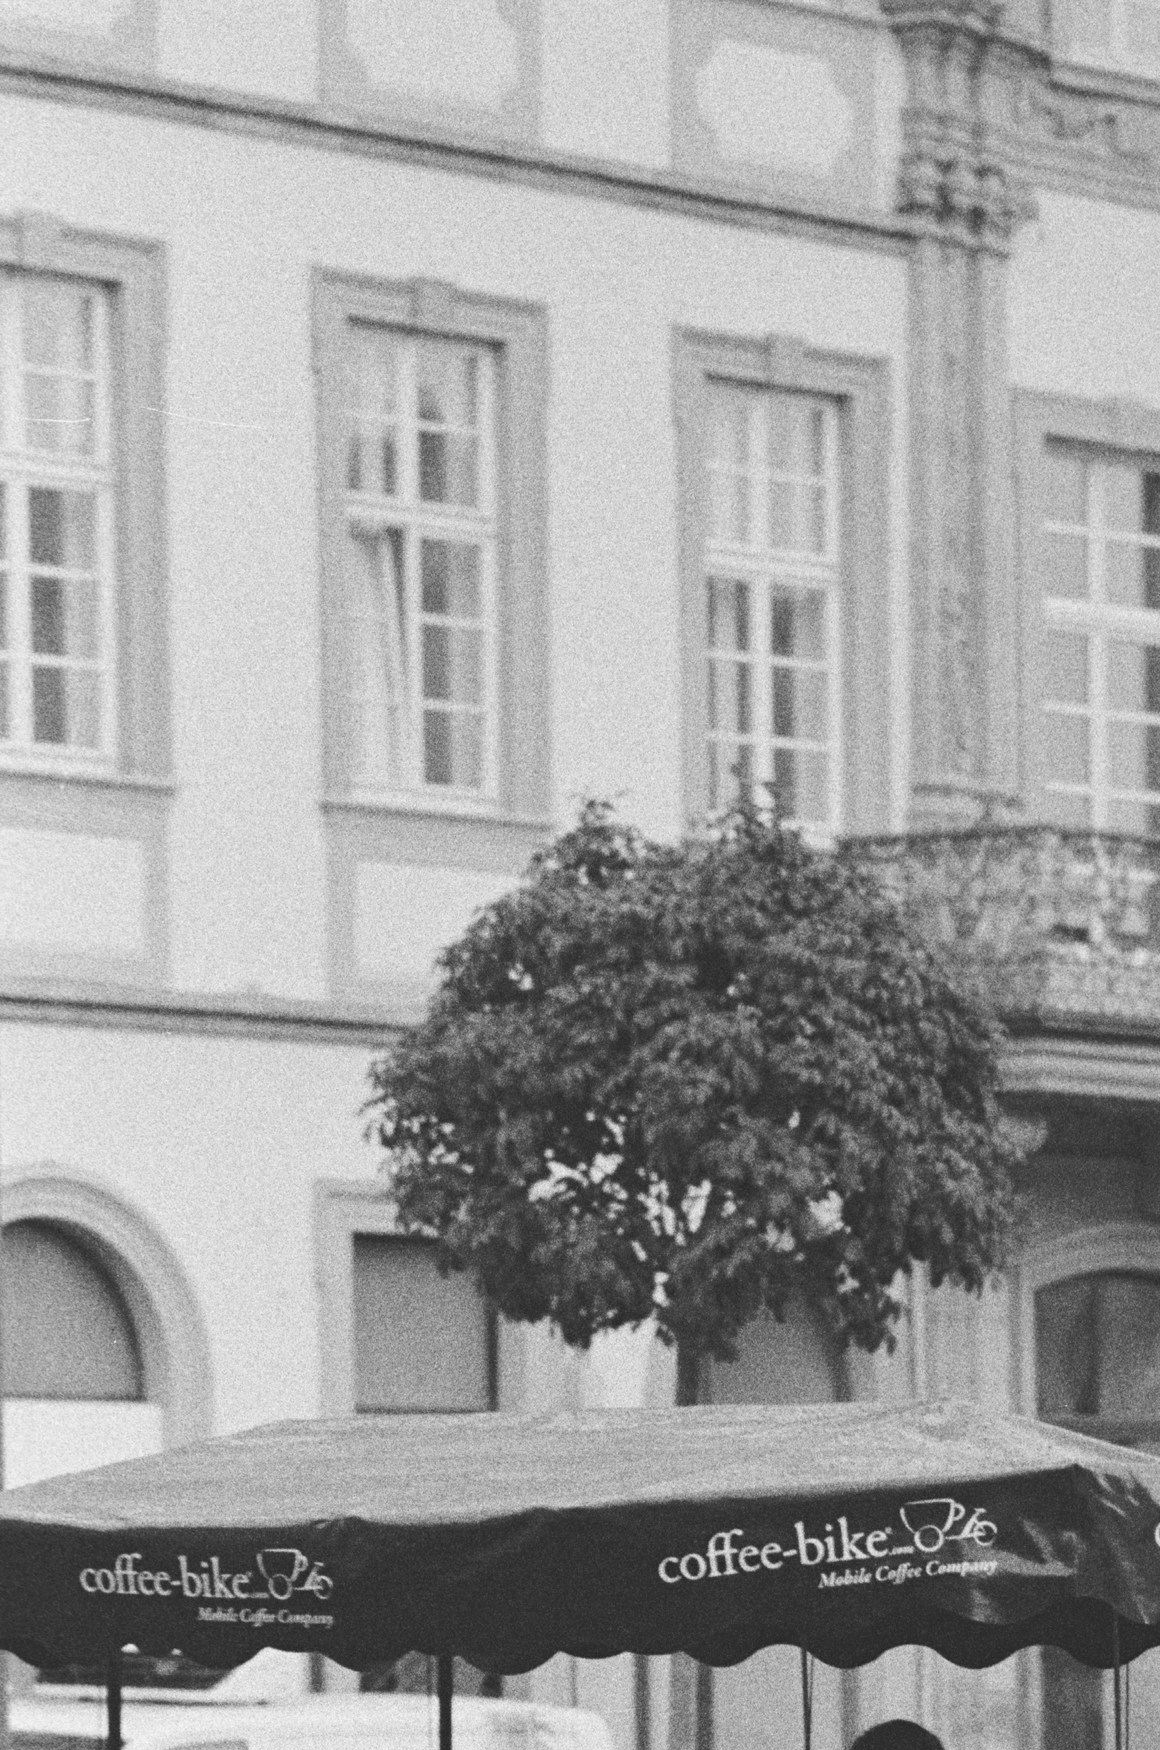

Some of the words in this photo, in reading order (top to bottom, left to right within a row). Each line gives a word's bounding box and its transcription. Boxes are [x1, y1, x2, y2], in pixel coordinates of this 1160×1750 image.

[818, 1570, 872, 1588] Mobile
[874, 1563, 922, 1585] Coffee
[925, 1559, 998, 1577] Company
